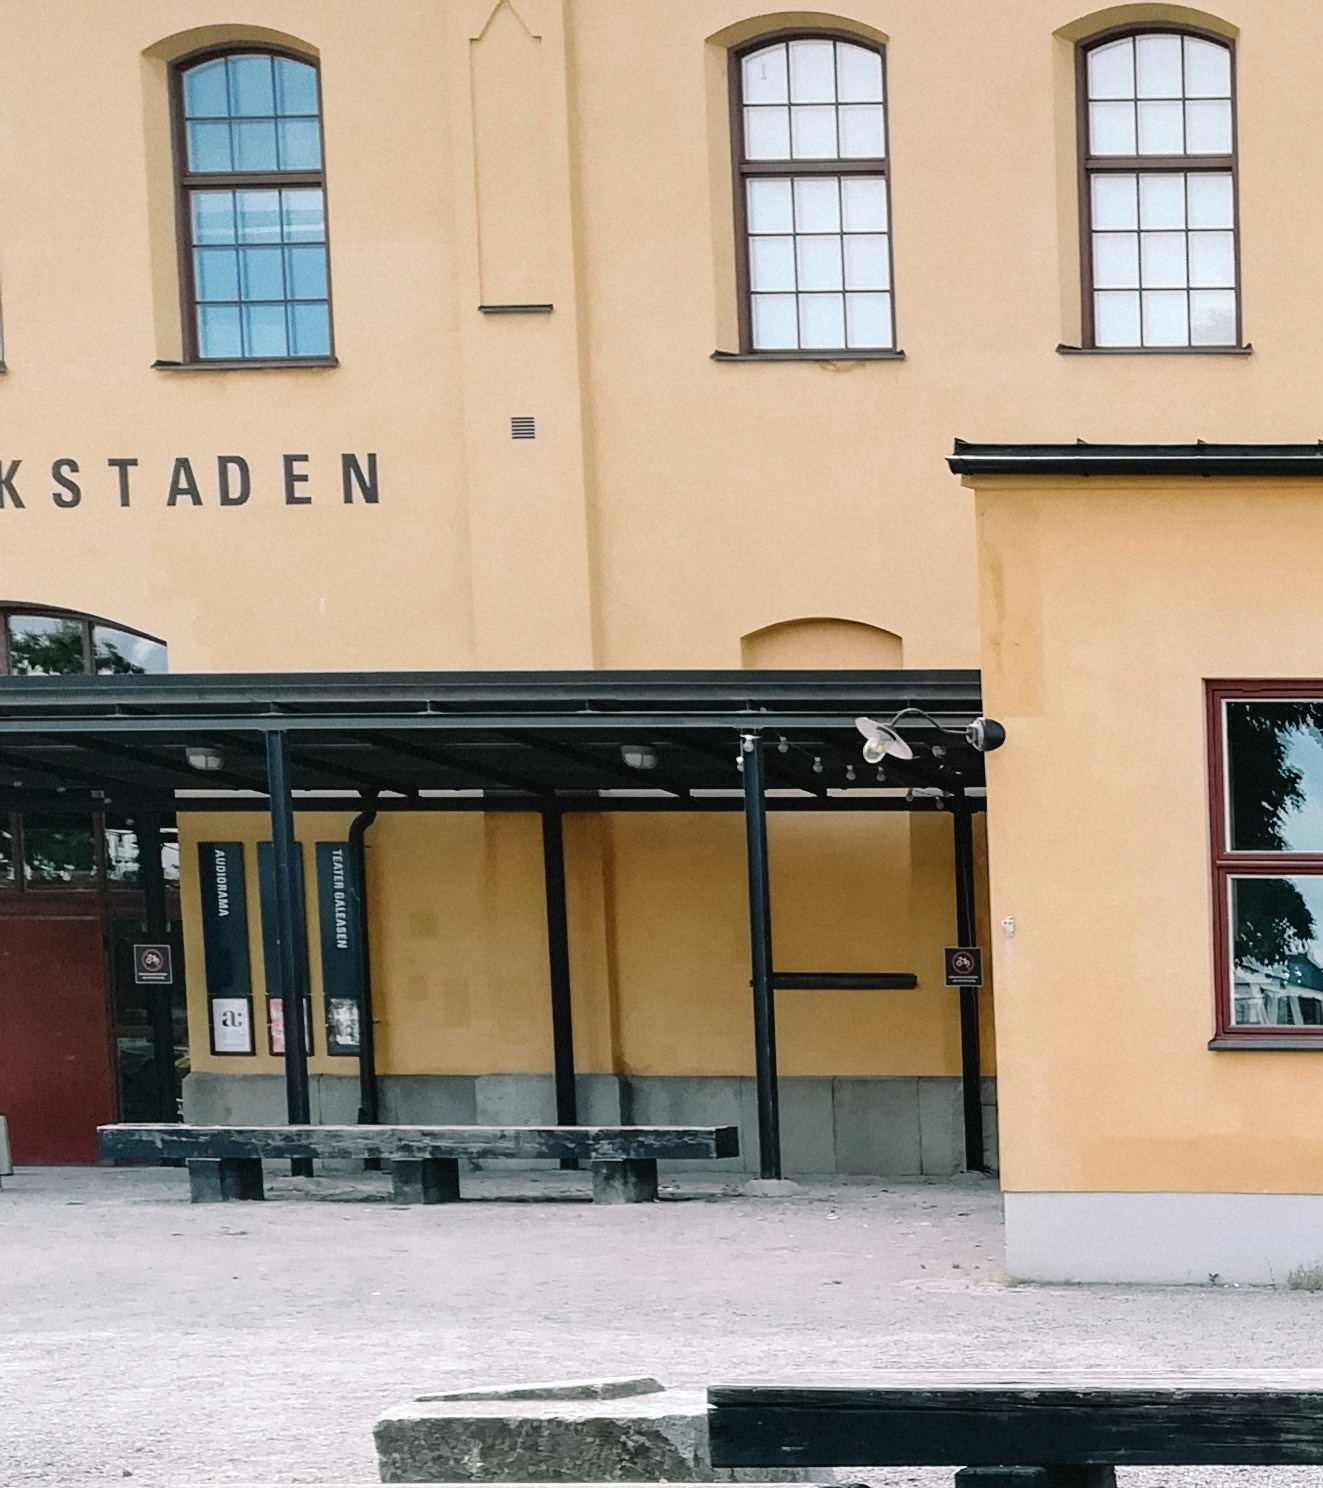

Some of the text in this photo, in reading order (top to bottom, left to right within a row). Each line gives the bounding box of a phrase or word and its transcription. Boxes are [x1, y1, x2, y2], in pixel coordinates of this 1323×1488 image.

[214, 850, 230, 917] AUDIORAMA
[332, 849, 348, 948] TEATER GALEASEN
